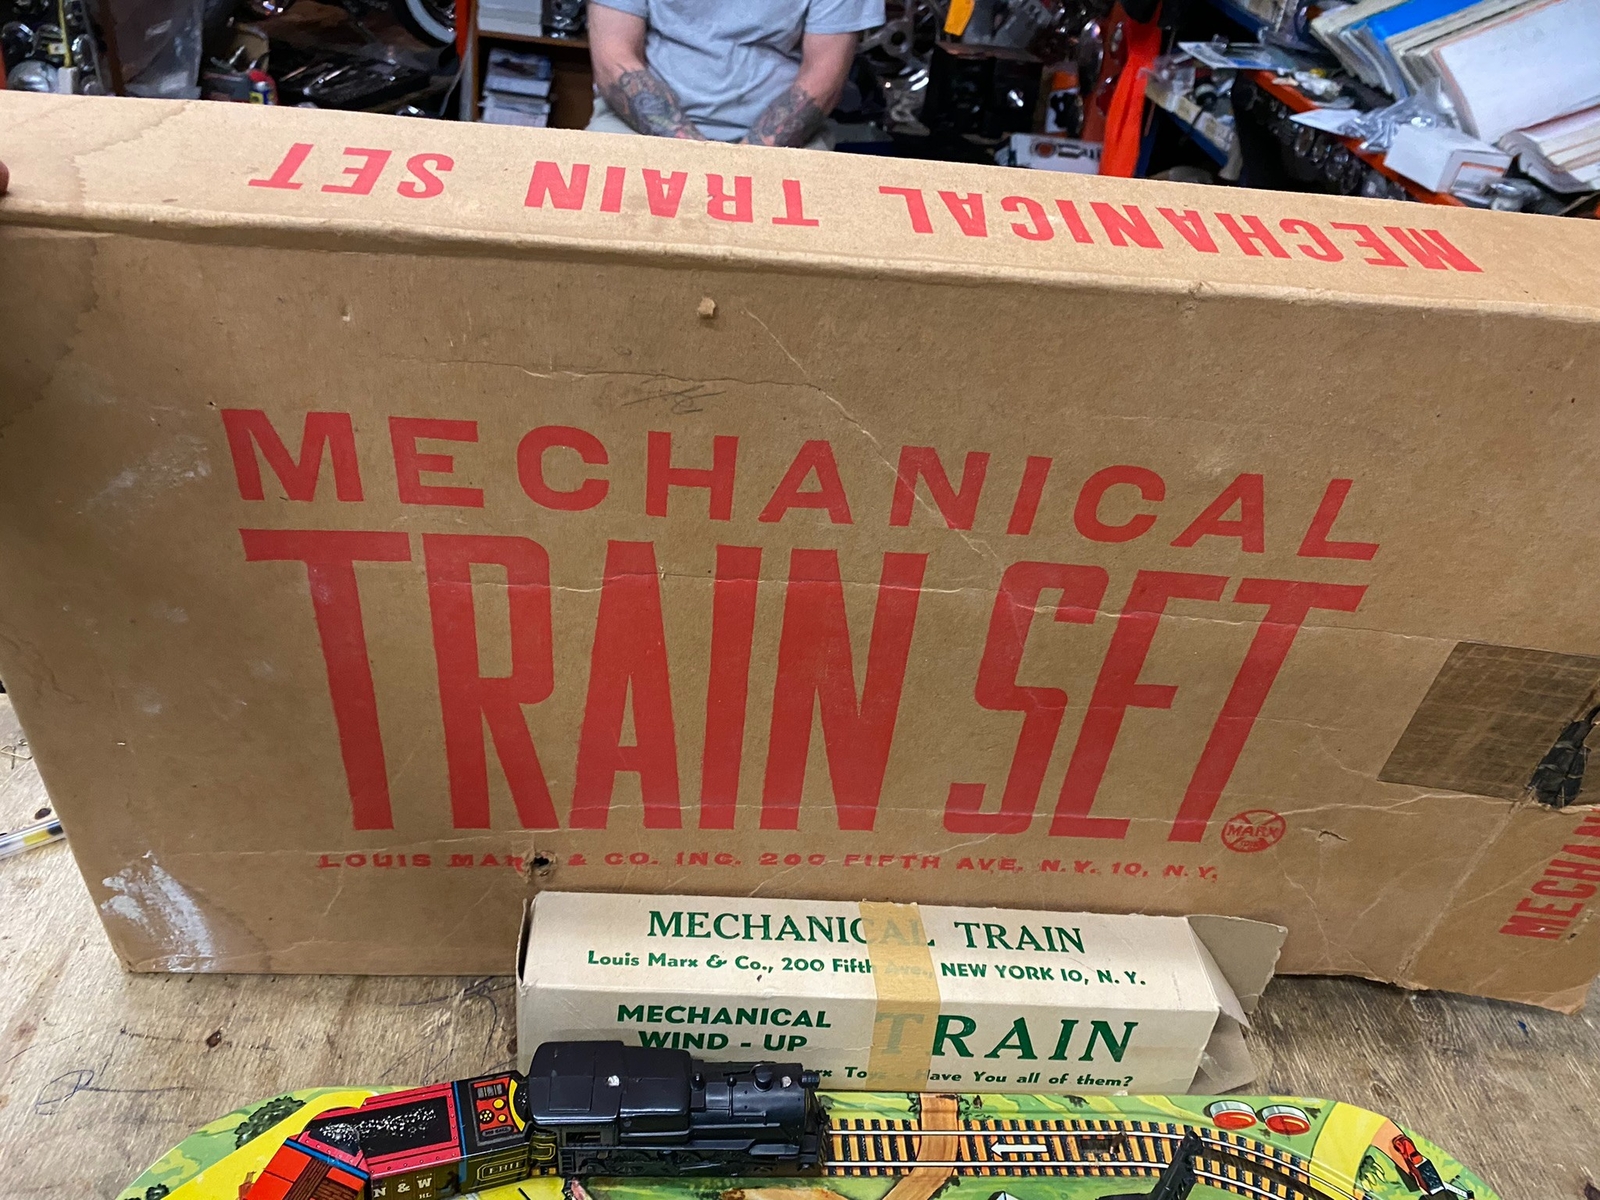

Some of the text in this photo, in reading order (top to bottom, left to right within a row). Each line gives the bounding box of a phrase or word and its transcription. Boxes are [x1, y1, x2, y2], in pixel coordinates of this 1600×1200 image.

[248, 143, 1483, 273] MECHANICAL TRAIN SET
[220, 408, 1380, 561] MECHANICAL
[239, 528, 1369, 842] TRAIN SET
[316, 853, 431, 869] LOUIS
[604, 852, 659, 866] CO.
[674, 852, 742, 867] INC.
[843, 854, 941, 870] FIFTH
[956, 857, 1024, 874] AVE.
[953, 921, 1086, 954] TRAIN
[587, 949, 640, 967] Louis
[647, 952, 699, 968] Marx
[705, 953, 728, 970] &
[734, 955, 774, 974] Co.,
[781, 957, 826, 973] 200
[832, 957, 877, 974] Fifth
[940, 962, 987, 978] NEW
[995, 964, 1055, 981] YORK
[616, 1004, 831, 1029] MECHANICAL
[637, 1030, 729, 1051] WIND
[763, 1033, 808, 1052] UP
[875, 1011, 1139, 1063] TRAIN
[973, 1070, 1007, 1083] You
[1016, 1072, 1041, 1084] all
[1048, 1072, 1069, 1085] of
[1076, 1074, 1134, 1087] them?
[373, 1177, 432, 1198] N & W
